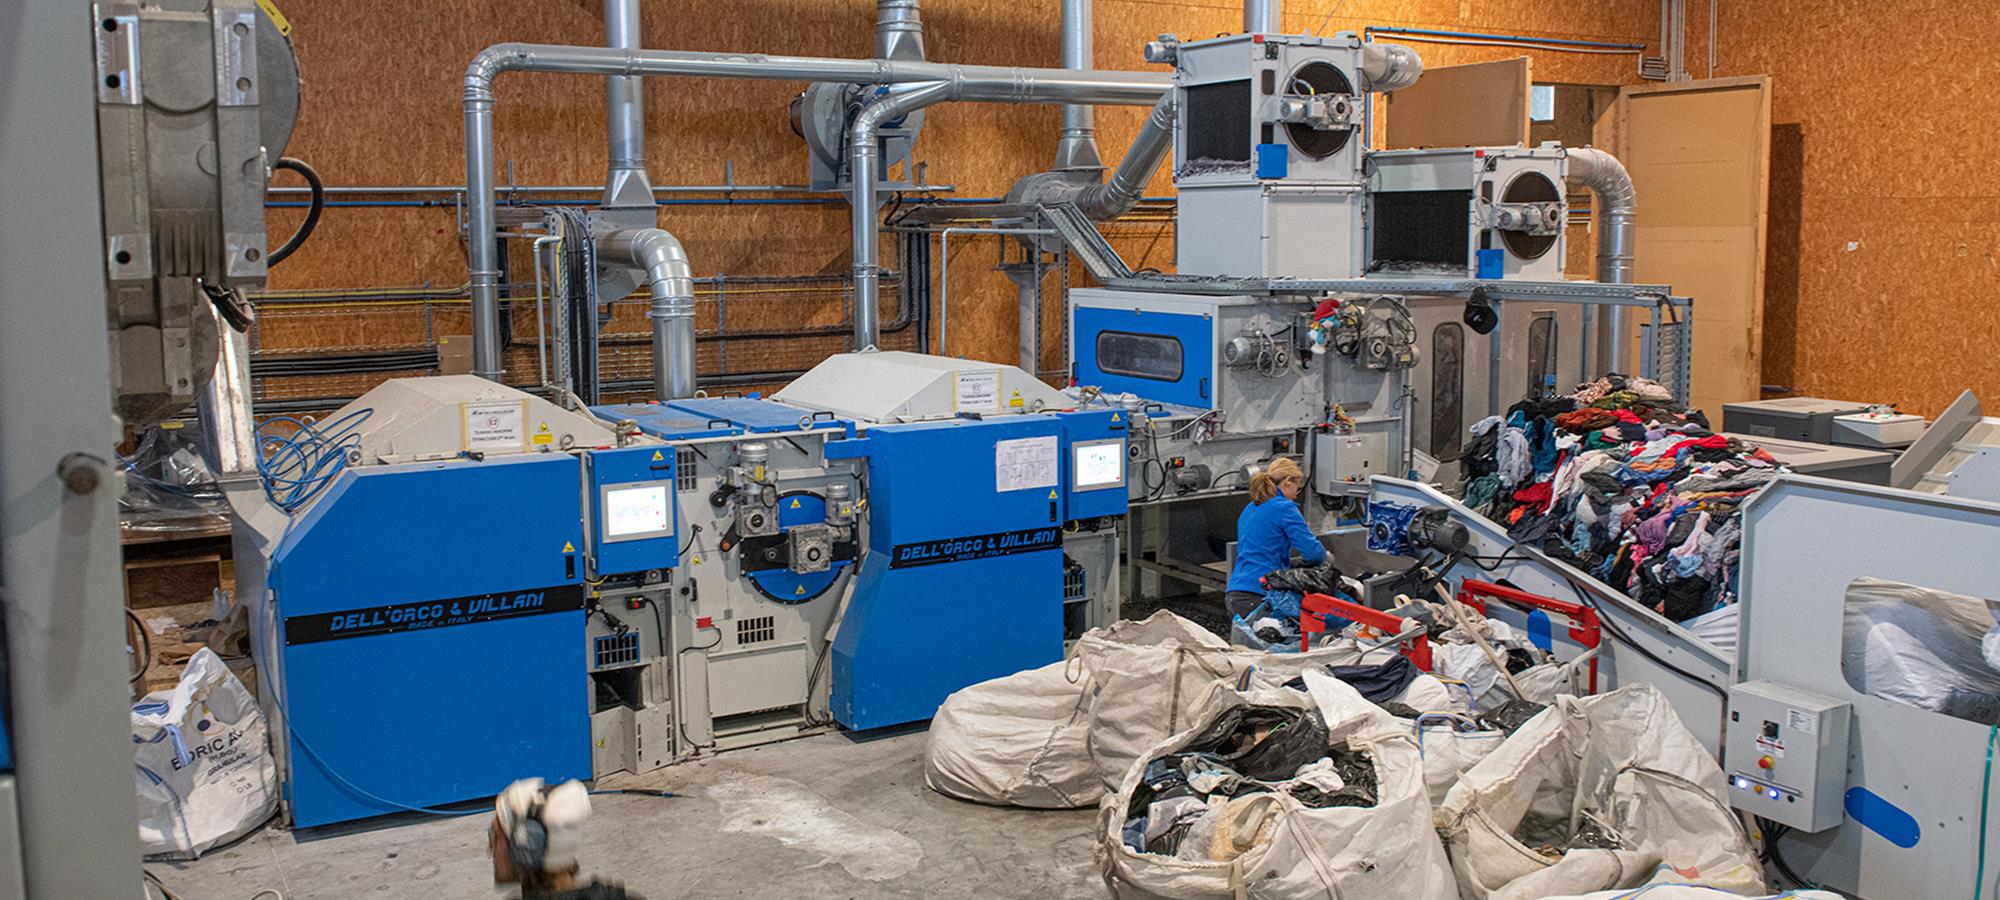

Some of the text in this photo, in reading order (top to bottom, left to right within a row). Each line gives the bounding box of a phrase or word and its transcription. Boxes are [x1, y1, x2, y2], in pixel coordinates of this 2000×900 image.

[901, 530, 1056, 560] DELL'ORCO & VILLANI
[330, 592, 545, 631] DELL'ORCO & VILLANI
